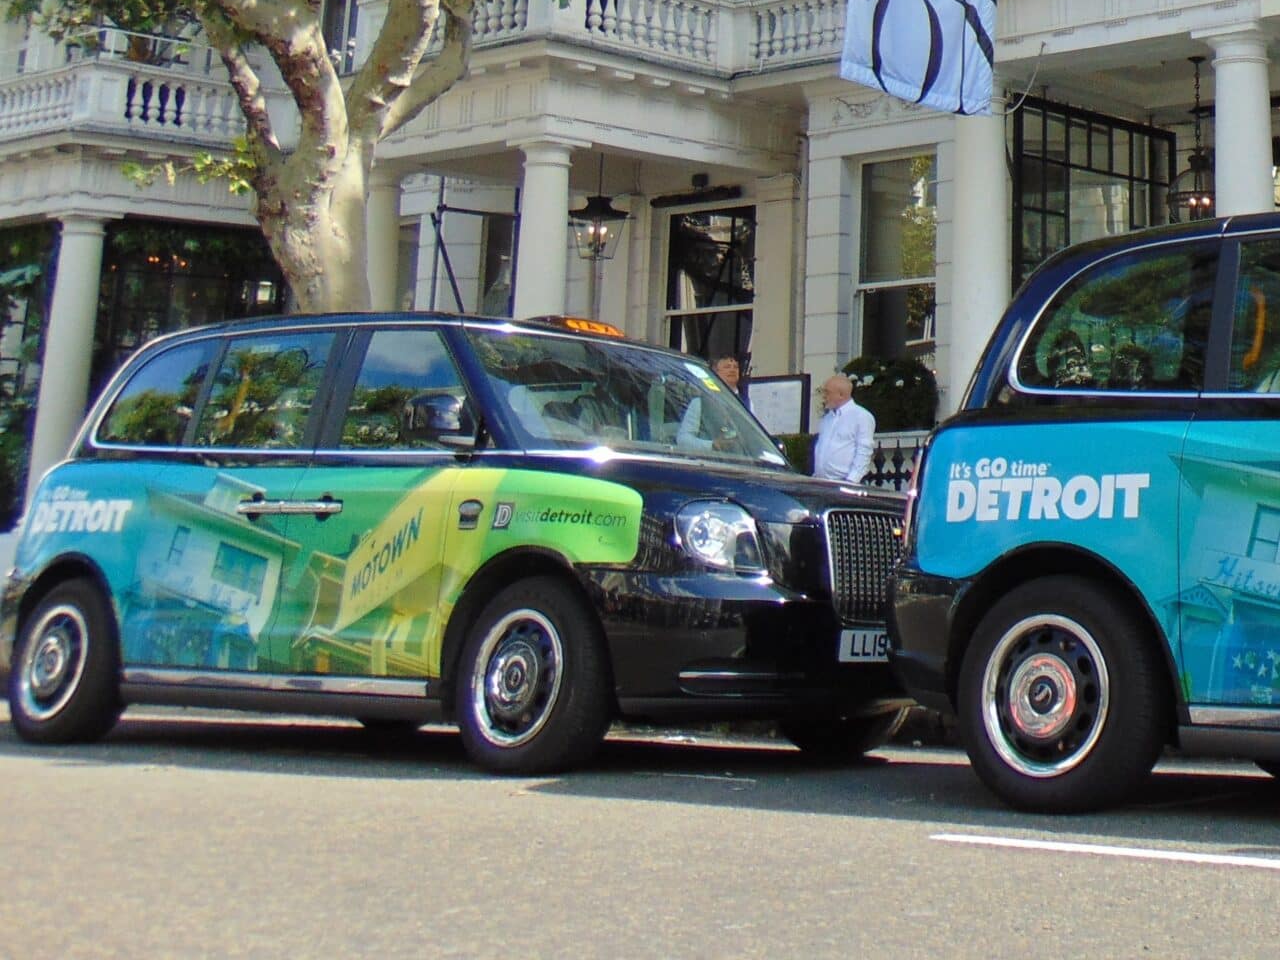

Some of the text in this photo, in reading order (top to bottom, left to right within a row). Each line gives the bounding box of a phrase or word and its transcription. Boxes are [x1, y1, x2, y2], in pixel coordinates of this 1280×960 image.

[950, 462, 970, 478] It's
[975, 457, 1007, 478] GO
[31, 499, 133, 533] DETROIT
[946, 473, 1150, 522] DETROIT
[352, 507, 423, 599] MOTOWN
